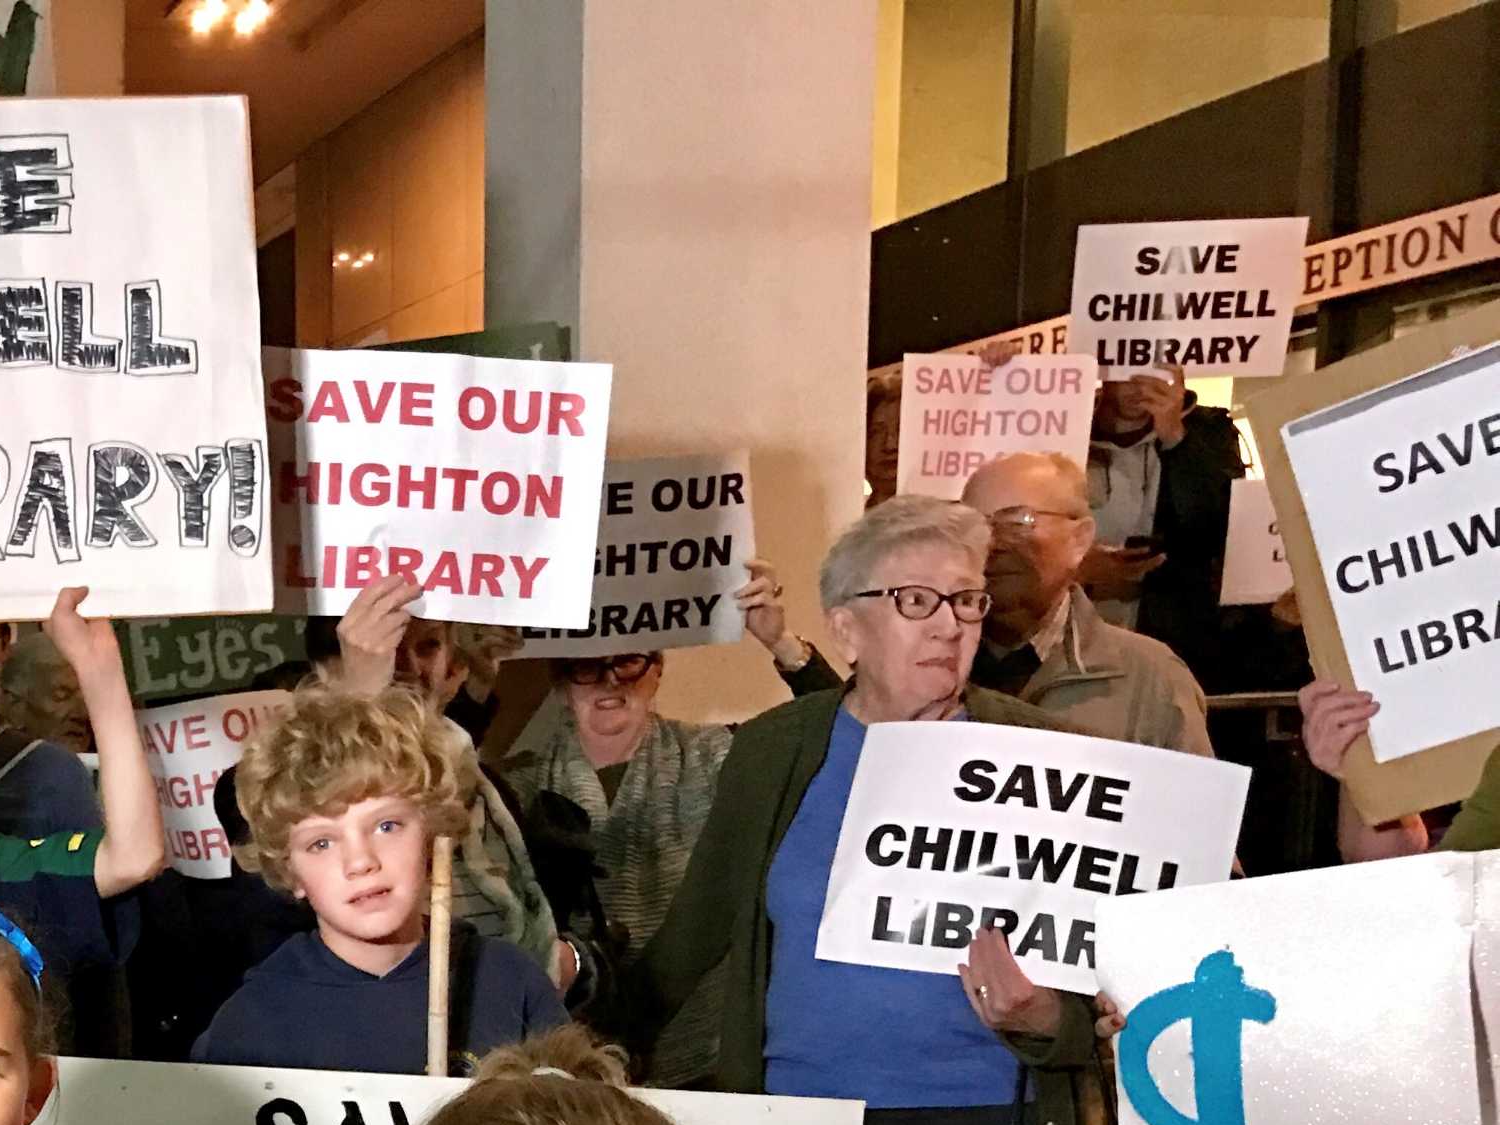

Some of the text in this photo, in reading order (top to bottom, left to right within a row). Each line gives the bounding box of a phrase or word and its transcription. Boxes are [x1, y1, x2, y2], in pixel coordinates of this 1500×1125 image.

[1135, 244, 1240, 276] SAVE
[1302, 213, 1469, 295] EPTION
[1088, 289, 1276, 322] CHILWELL
[1097, 335, 1260, 366] LIBRARY
[915, 366, 1083, 395] SAVE OUR
[269, 378, 586, 437] SAVE OUR
[922, 409, 1069, 437] HIGHTON
[920, 451, 987, 478] LIBR
[1373, 413, 1500, 493] SAVE
[279, 462, 564, 520] HIGHTON
[651, 472, 745, 513] OUR
[285, 545, 550, 600] LIBRARY
[1336, 506, 1500, 594] CHILW
[143, 715, 211, 754] AVE
[953, 759, 1131, 823] SAVE
[871, 895, 1096, 969] LIBRAR
